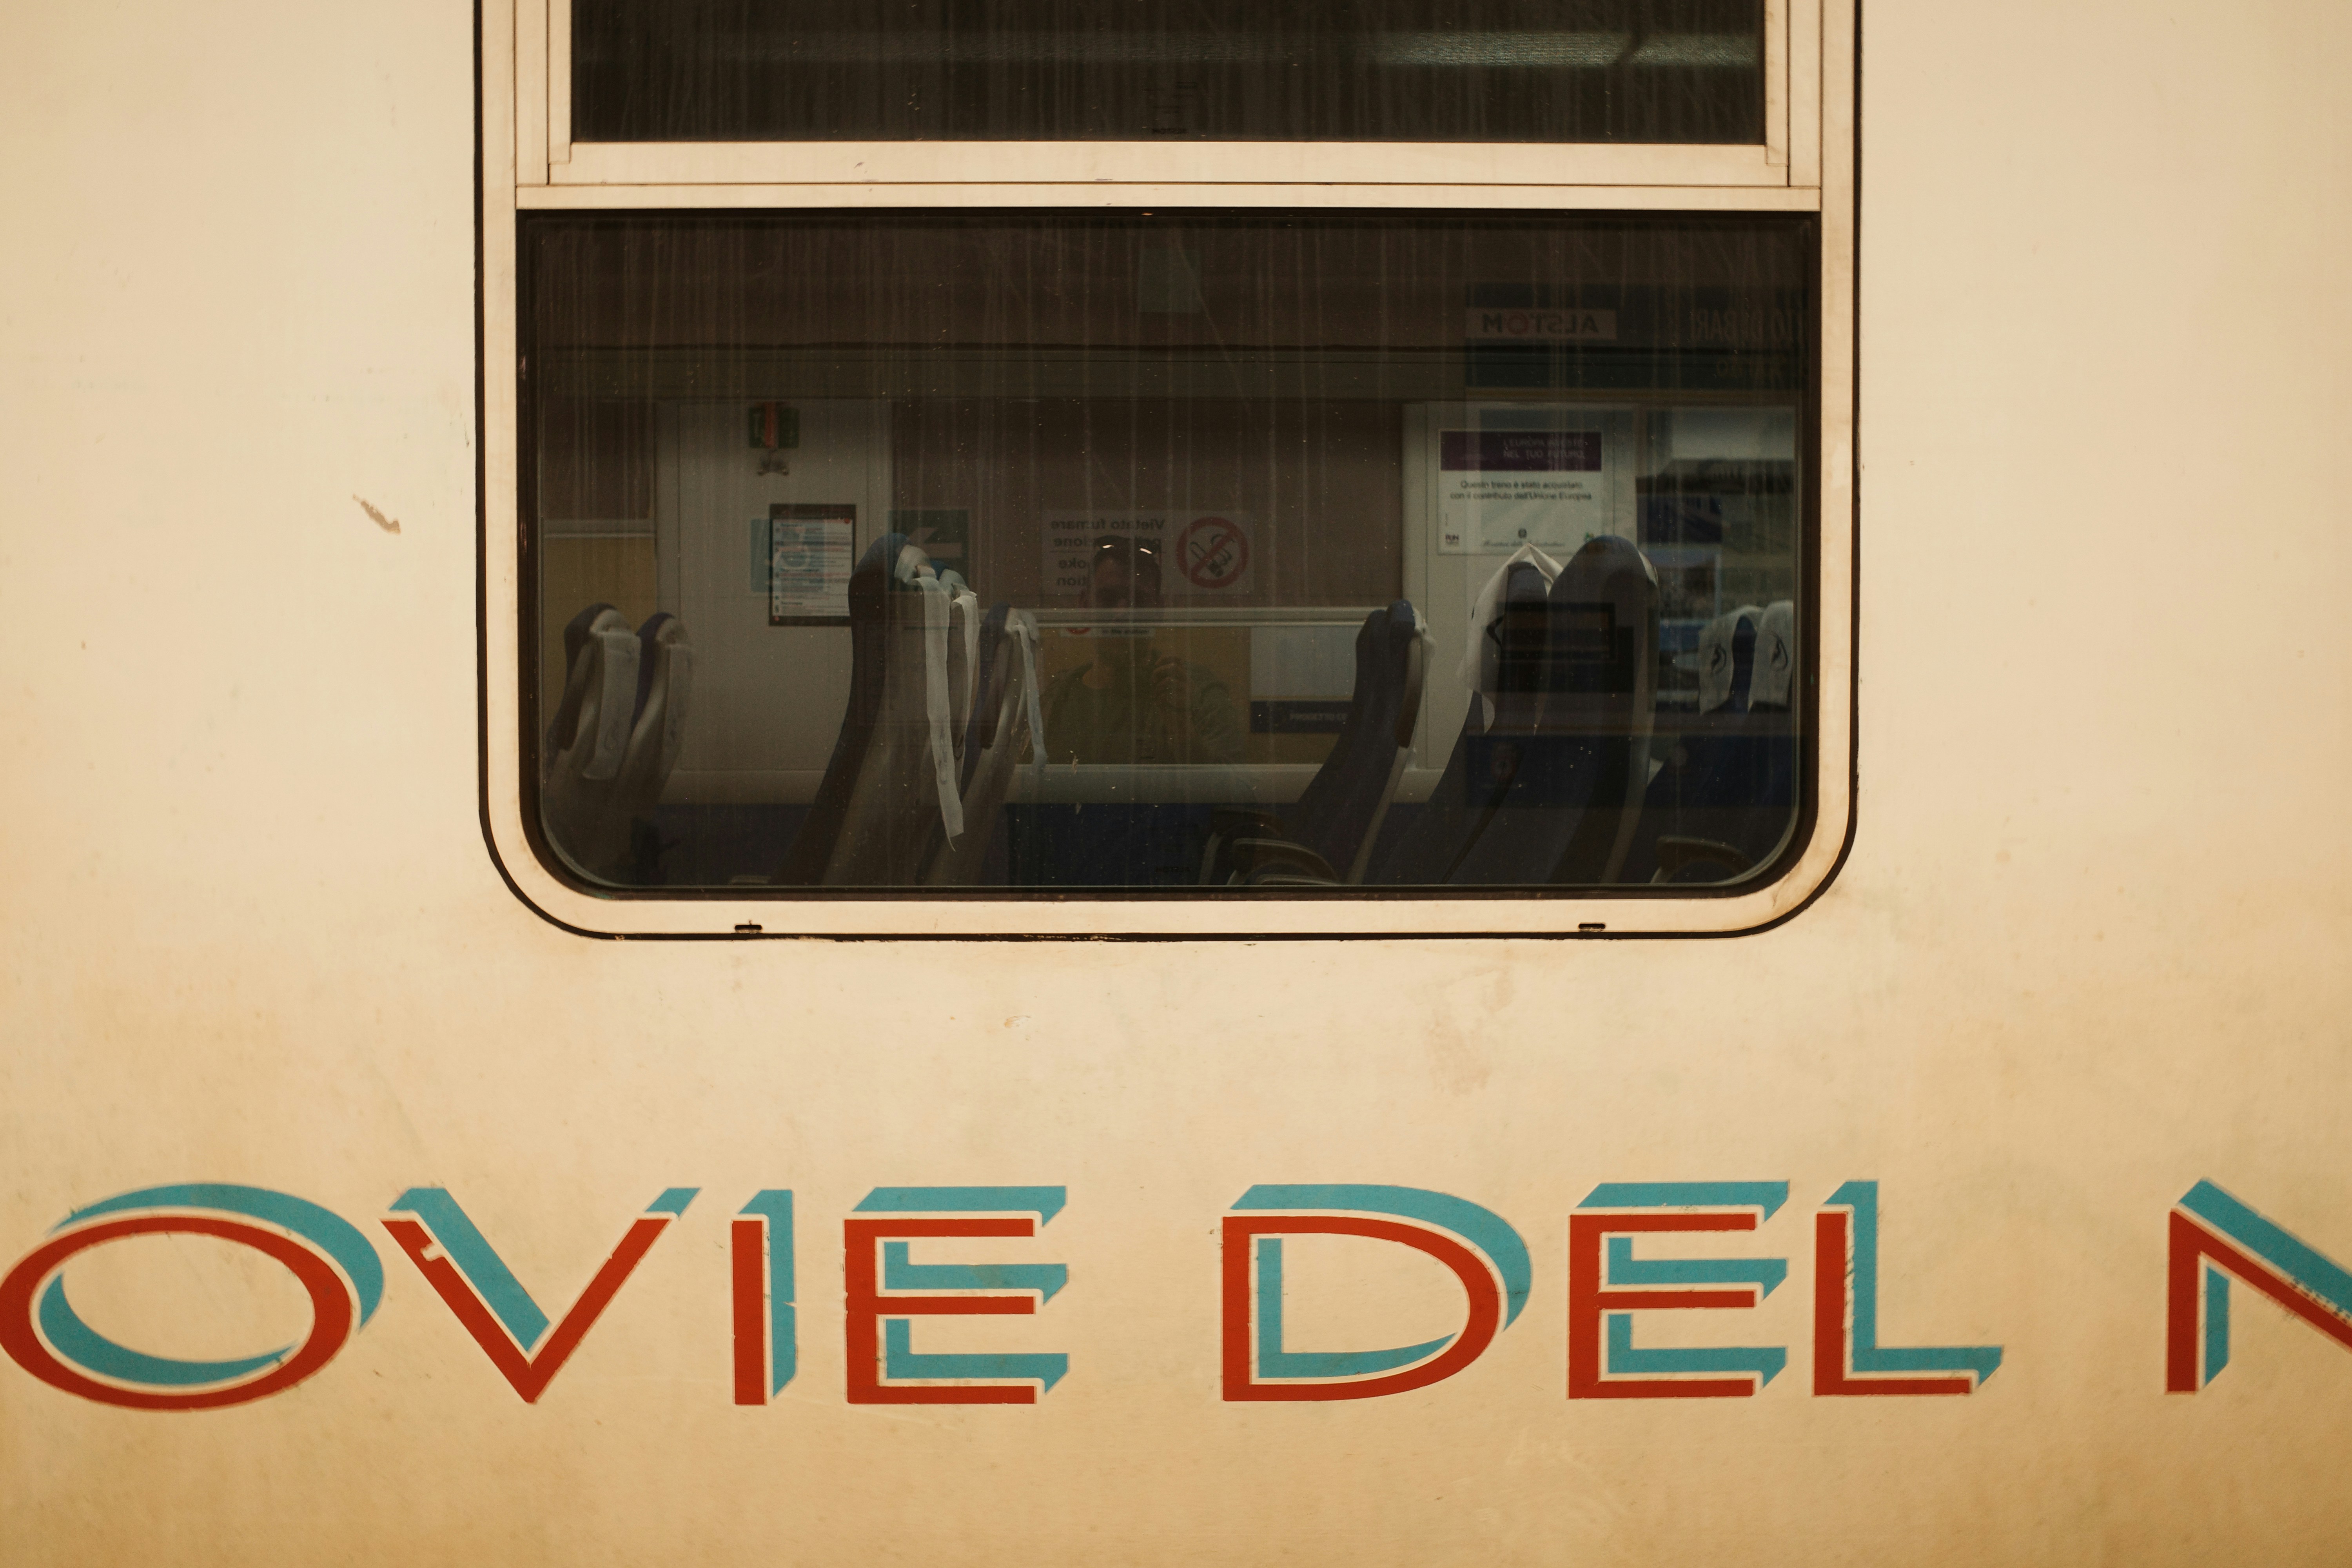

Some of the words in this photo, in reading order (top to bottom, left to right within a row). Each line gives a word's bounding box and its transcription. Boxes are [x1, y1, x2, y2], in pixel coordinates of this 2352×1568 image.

[1503, 450, 1519, 458] NEL
[1525, 450, 1543, 458] TUO
[1460, 480, 1489, 488] Questo
[1543, 481, 1583, 490] acquistato
[1559, 492, 1592, 501] Europea
[0, 1181, 1069, 1410] OVIE
[1221, 1179, 2004, 1403] DEL
